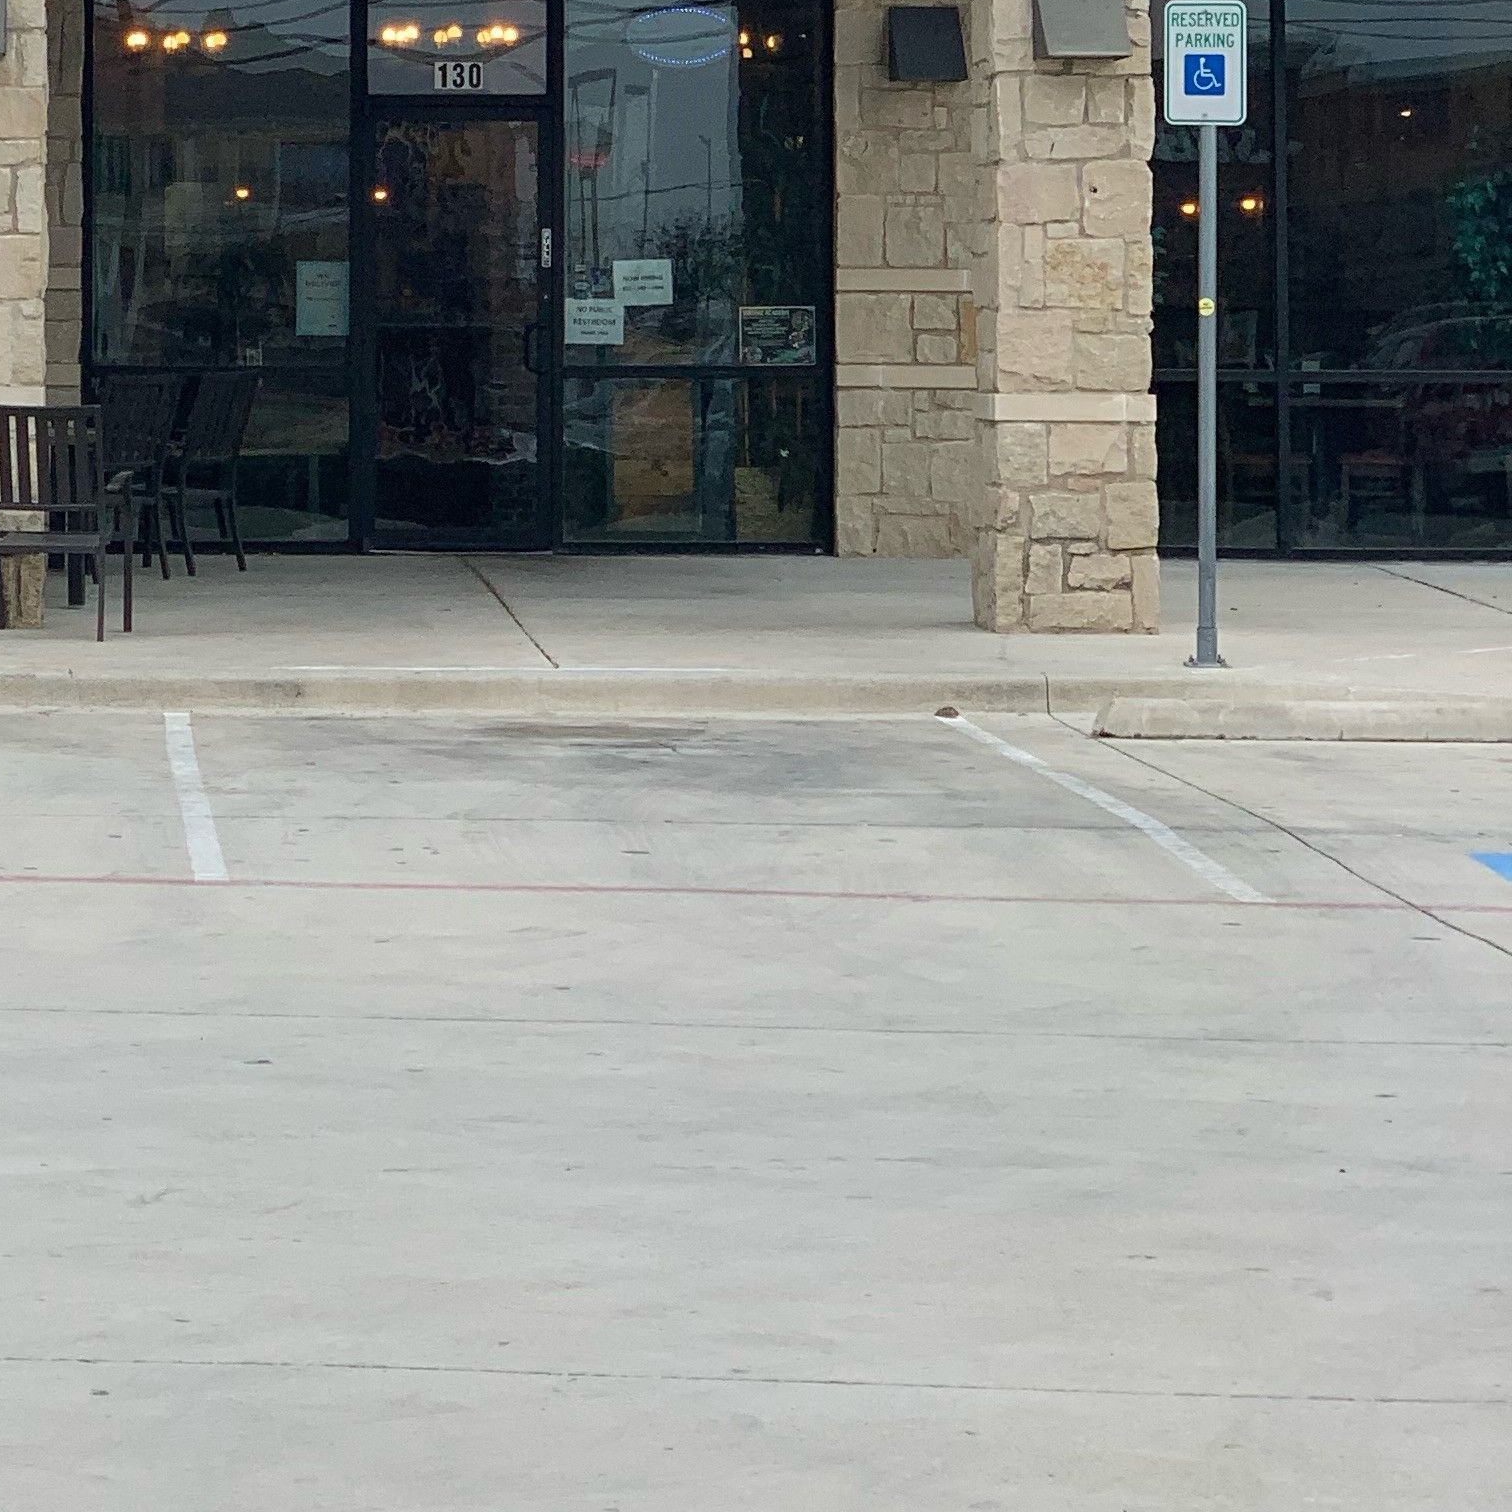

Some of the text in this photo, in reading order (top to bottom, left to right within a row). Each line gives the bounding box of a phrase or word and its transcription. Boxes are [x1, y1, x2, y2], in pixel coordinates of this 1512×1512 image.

[1171, 12, 1240, 28] RESERVED
[1175, 33, 1235, 48] PARKING
[438, 62, 482, 89] 130
